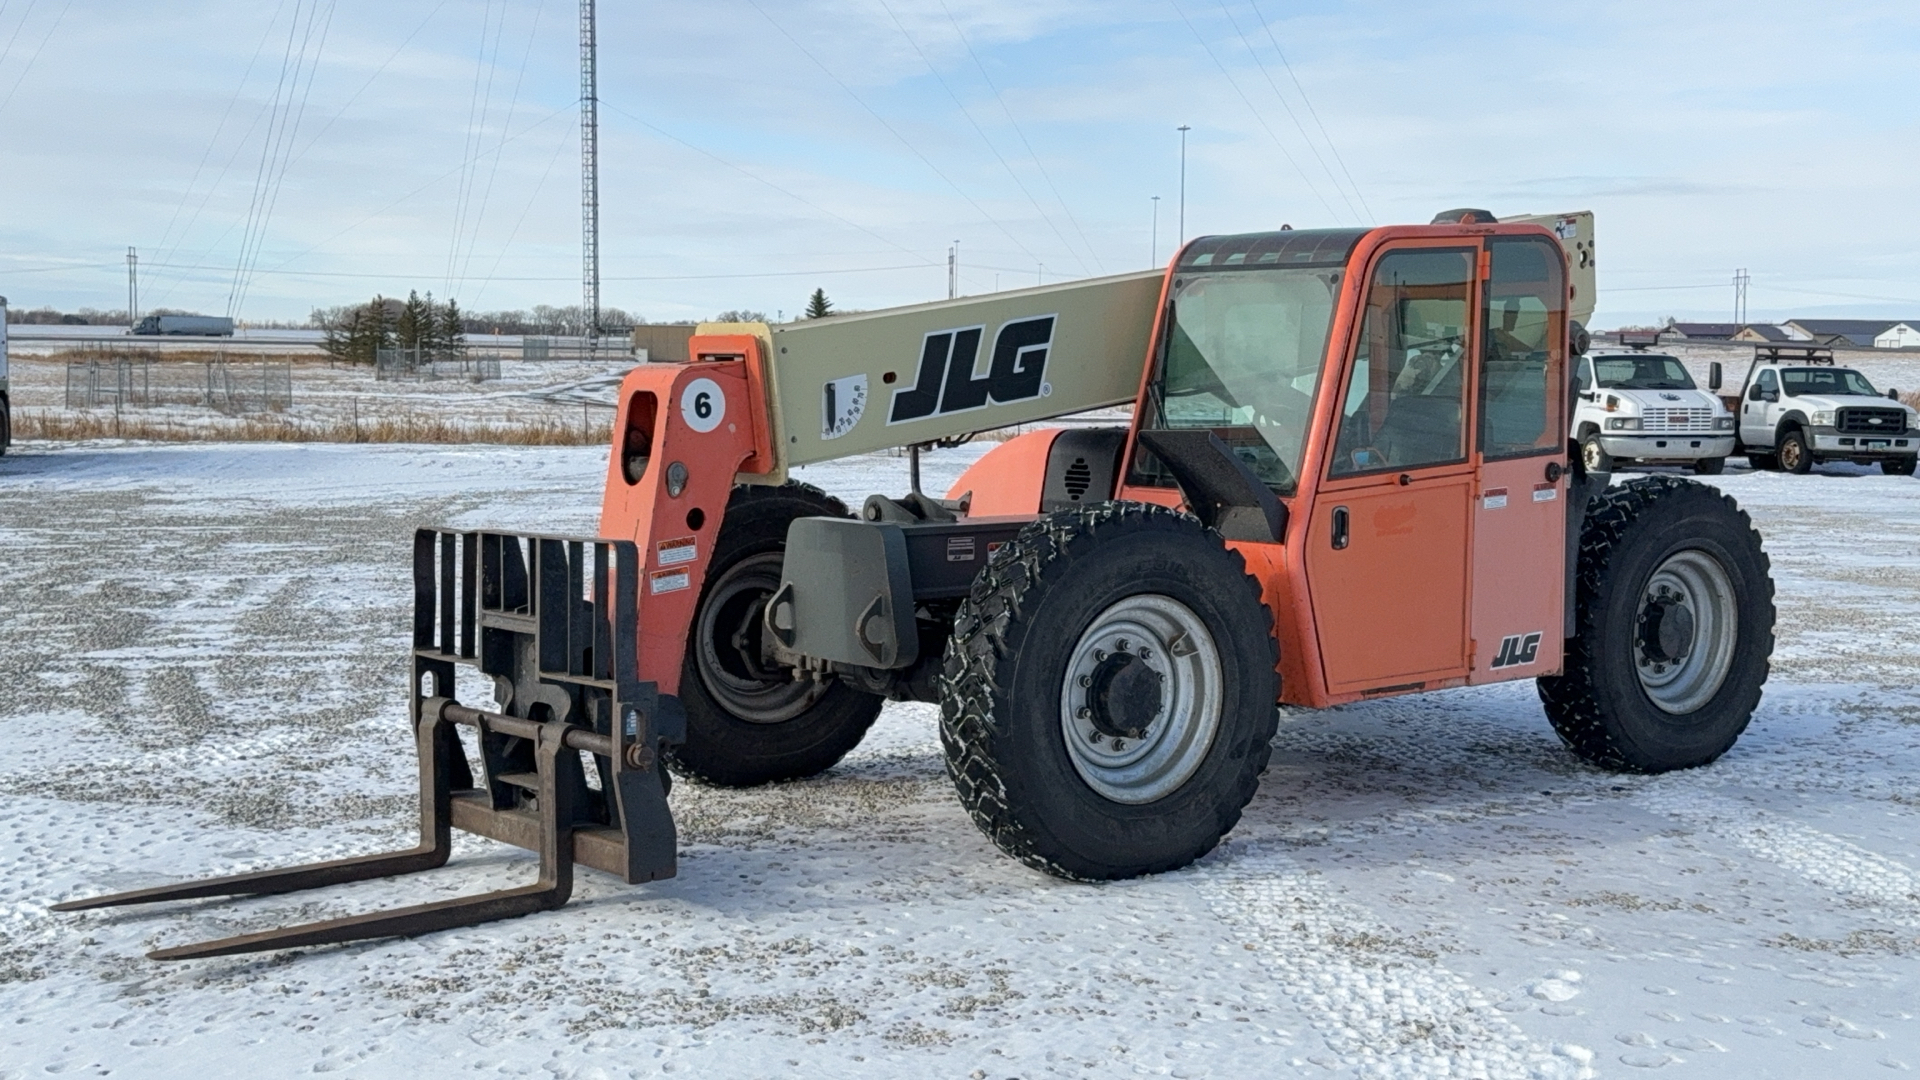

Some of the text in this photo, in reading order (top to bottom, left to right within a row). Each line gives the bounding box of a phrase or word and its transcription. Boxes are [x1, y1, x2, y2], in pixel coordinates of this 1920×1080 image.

[888, 314, 1057, 425] JLG
[694, 392, 712, 419] 6
[666, 537, 695, 549] WARNING
[1490, 631, 1544, 670] JLG
